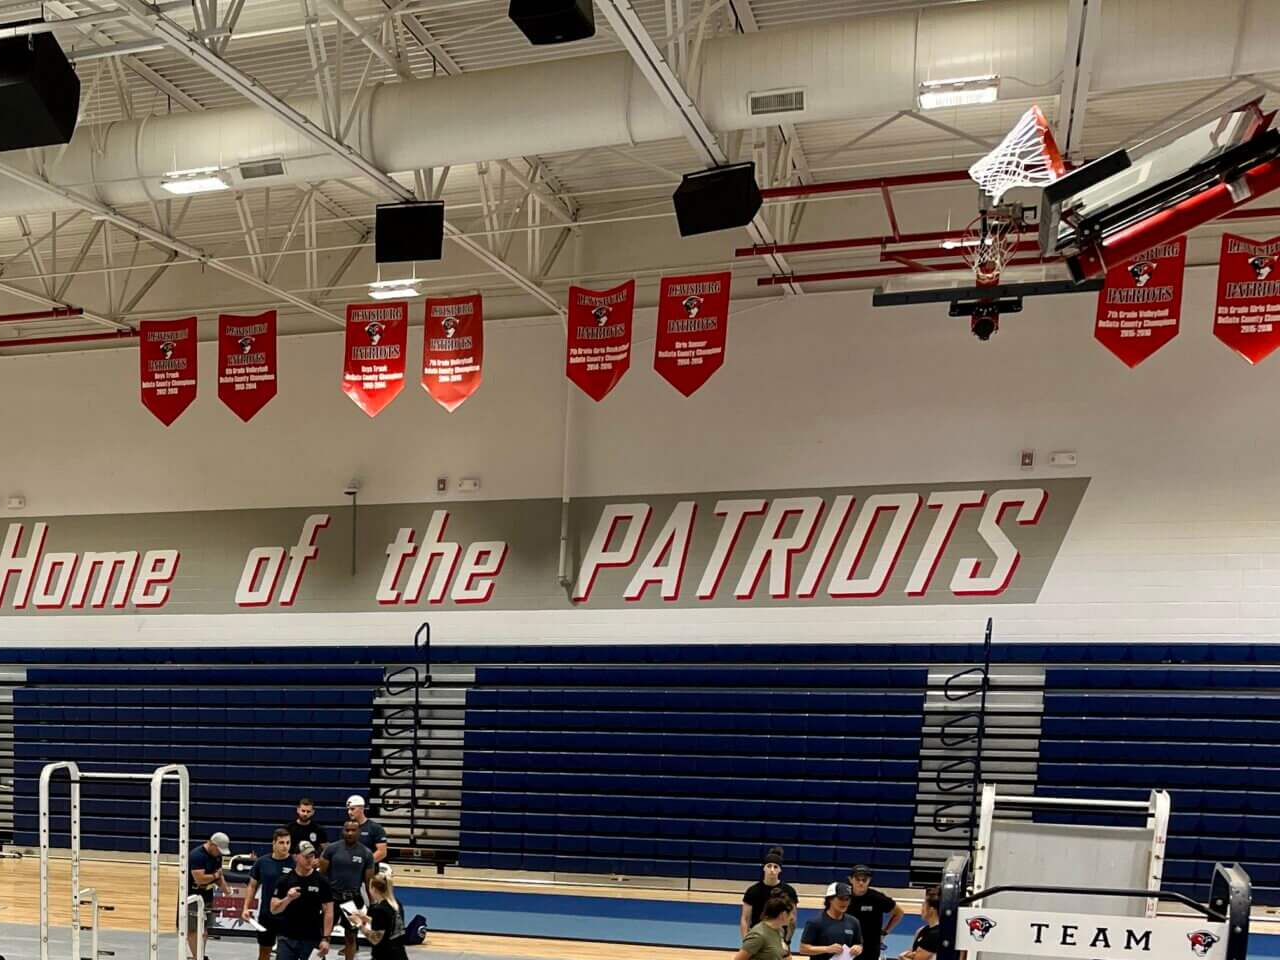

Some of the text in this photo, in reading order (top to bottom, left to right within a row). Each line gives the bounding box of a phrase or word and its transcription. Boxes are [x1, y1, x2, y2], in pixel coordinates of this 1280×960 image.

[351, 307, 403, 322] LEWISBURG
[234, 514, 330, 608] of
[375, 509, 509, 606] the
[572, 487, 1049, 603] PATRIOTS
[1030, 923, 1152, 951] TEAM
